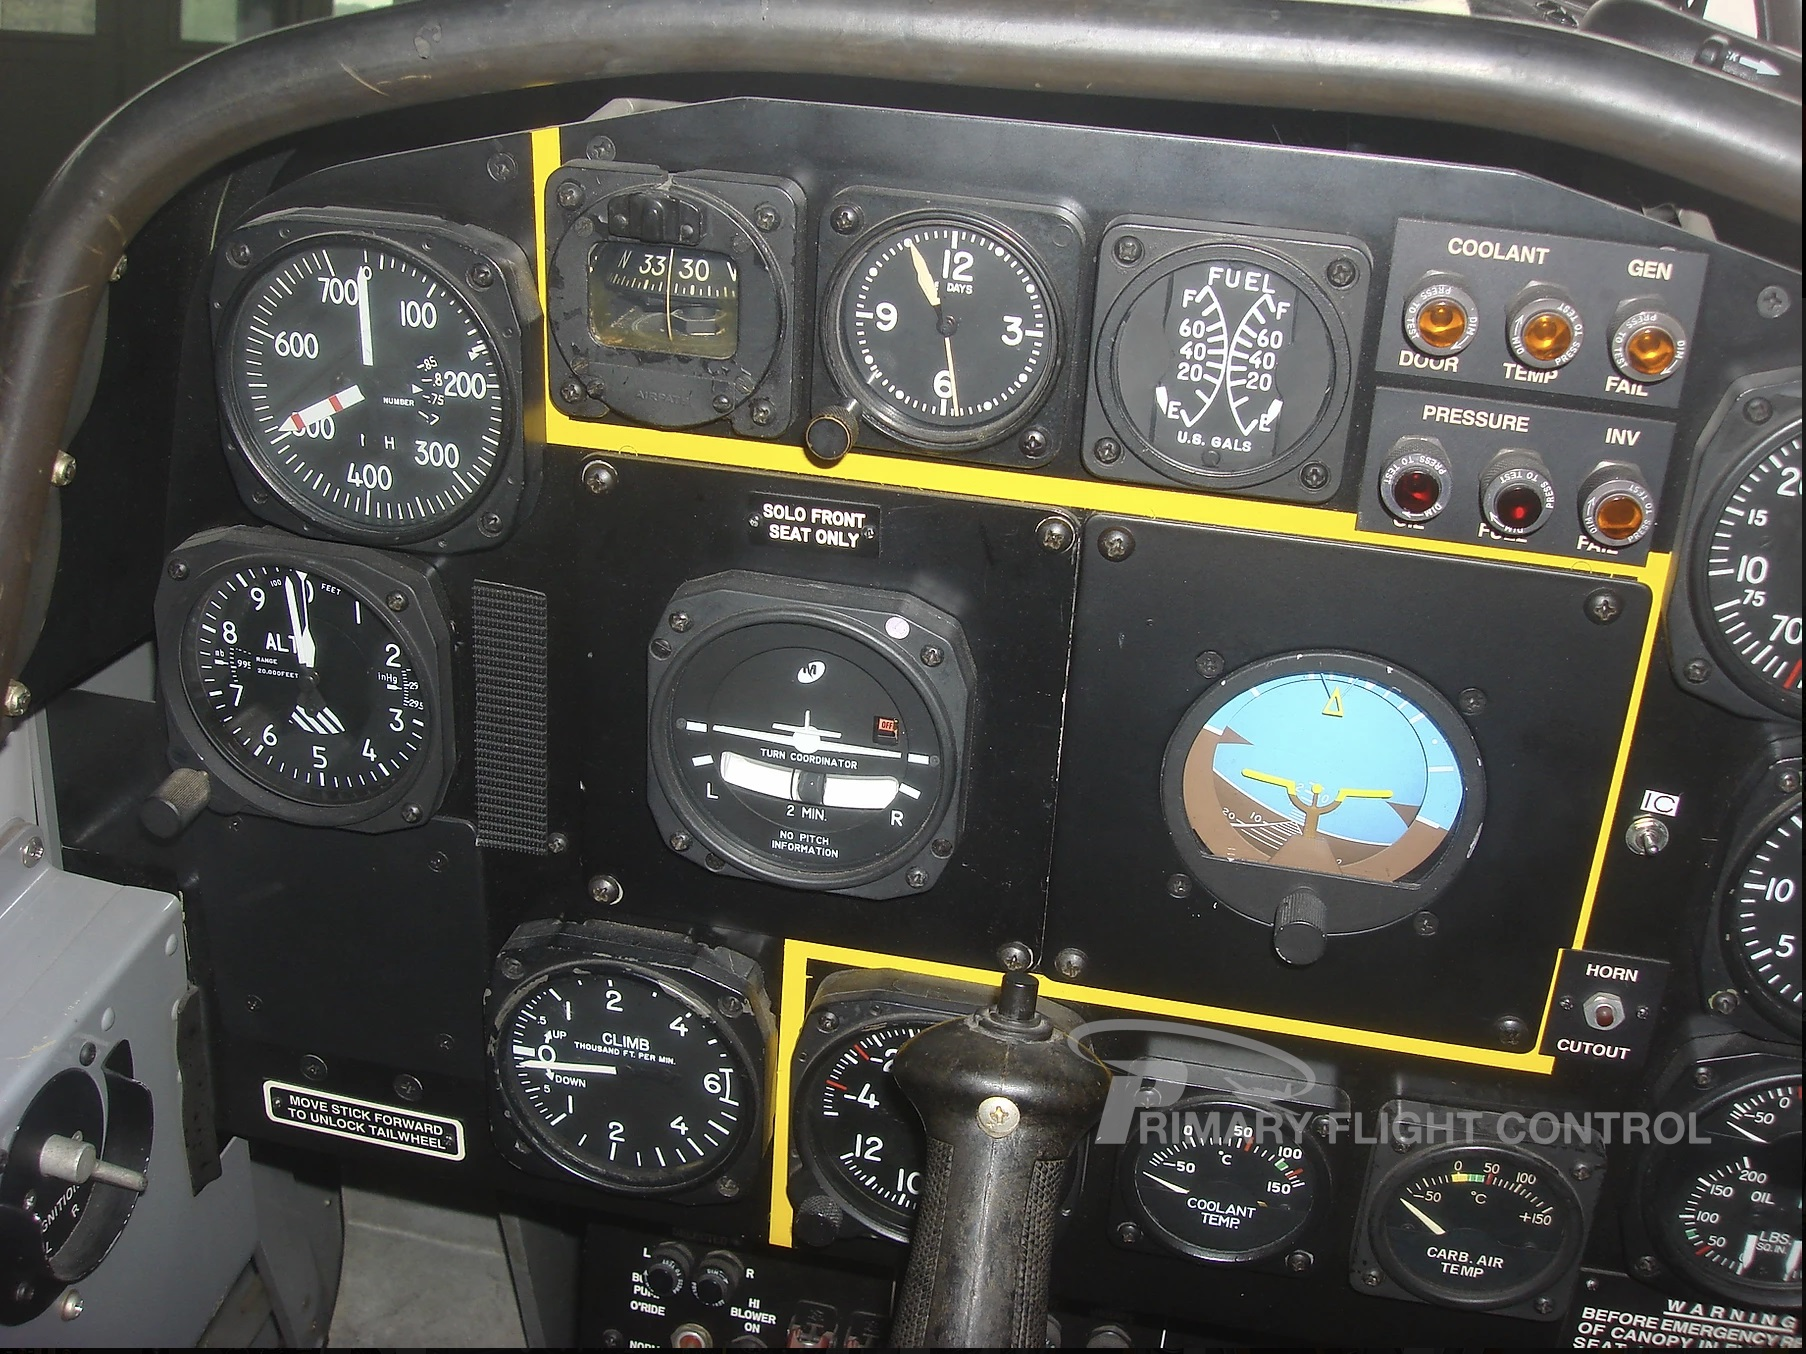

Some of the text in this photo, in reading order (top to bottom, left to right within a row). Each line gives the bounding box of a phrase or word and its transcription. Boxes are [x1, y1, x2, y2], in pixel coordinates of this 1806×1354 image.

[1447, 237, 1550, 265] COOLANT
[619, 250, 632, 268] N
[639, 254, 666, 276] 33
[679, 258, 710, 281] 30
[942, 249, 974, 282] 12
[1627, 258, 1673, 281] GEN
[946, 282, 973, 294] DAYS
[1207, 266, 1275, 294] FUEL
[317, 277, 358, 306] 700
[1182, 288, 1197, 308] F
[400, 300, 437, 329] 100
[875, 302, 898, 331] 9
[1276, 301, 1291, 320] F
[1406, 286, 1452, 339] PRESS TO TEST
[1001, 315, 1023, 346] 3
[1179, 318, 1206, 338] 60
[1466, 316, 1478, 336] DIM
[1554, 302, 1583, 366] PRESS TO TEST
[274, 331, 319, 360] 600
[1257, 329, 1283, 349] 60
[1512, 336, 1525, 355] DIM
[1614, 314, 1658, 369] PRESS TEST
[1675, 340, 1685, 359] DIM
[1180, 340, 1206, 361] 40
[1249, 351, 1275, 370] 40
[1176, 361, 1203, 382] 20
[1399, 350, 1459, 373] DOOR
[1246, 371, 1272, 392] 20
[1503, 362, 1558, 384] TEMP
[444, 370, 487, 399] 200
[933, 370, 953, 399] 6
[1605, 375, 1648, 397] FAIL
[383, 397, 415, 406] NUMBER
[1167, 400, 1182, 419] E
[1422, 404, 1530, 433] PRESSURE
[1177, 430, 1252, 452] U.S. GALS
[1605, 427, 1640, 447] INV
[414, 440, 460, 469] 300
[347, 462, 393, 491] 400
[1383, 455, 1447, 485] PRESS TO TEST
[1500, 471, 1555, 509] PRESS TO TEST
[763, 503, 866, 528] SOLO FRONT
[1423, 502, 1443, 517] DIM
[1747, 508, 1768, 527] 15
[1584, 516, 1598, 534] DIM
[768, 524, 860, 548] SEAT ONLY
[1736, 555, 1768, 585] 10
[250, 587, 265, 611] 9
[321, 583, 342, 596] FEET
[1742, 589, 1767, 608] 75
[222, 621, 238, 644] 8
[1769, 614, 1802, 645] 70
[385, 643, 401, 668] 2
[229, 683, 244, 707] 7
[389, 707, 405, 732] 3
[881, 720, 894, 730] OFF
[263, 723, 277, 747] 6
[312, 745, 328, 769] 5
[362, 738, 378, 762] 4
[760, 747, 858, 770] TURN COORDINATOR
[706, 782, 719, 800] L
[786, 804, 828, 822] 2 MIN.
[890, 809, 904, 827] R
[1221, 807, 1236, 820] 20
[1249, 811, 1263, 823] 10
[779, 829, 829, 846] NO PITCH
[771, 839, 839, 858] INFORMATION
[1765, 877, 1795, 903] 10
[1775, 934, 1795, 957] 5
[1585, 963, 1638, 982] HORN
[606, 989, 623, 1012] 2
[552, 1030, 567, 1039] UP
[669, 1016, 689, 1037] 4
[602, 1032, 650, 1051] CLIMB
[1557, 1038, 1631, 1060] CUTOUT
[574, 1041, 676, 1065] THOUSAND FT. PER MIN.
[555, 1074, 587, 1088] DOWN
[703, 1073, 721, 1095] 6
[1779, 1096, 1791, 1109] 0
[289, 1095, 444, 1136] MOVE STICK FORWARD
[670, 1116, 689, 1136] 4
[288, 1107, 447, 1150] TO UNLOCK TAILWHEEL
[608, 1121, 625, 1142] 2
[1183, 1125, 1193, 1136] 0
[1233, 1125, 1253, 1138] 50
[855, 1133, 884, 1162] 12
[1278, 1146, 1303, 1160] 100
[1454, 1160, 1463, 1171] 0
[1483, 1162, 1501, 1175] 50
[1516, 1171, 1537, 1185] 100
[1739, 1169, 1767, 1184] 200
[1267, 1181, 1291, 1195] 150
[1710, 1184, 1733, 1198] 150
[1751, 1190, 1775, 1205] OIL
[71, 1203, 80, 1218] R
[1186, 1197, 1256, 1219] COOLANT
[1518, 1211, 1552, 1226] +150
[1696, 1211, 1719, 1224] 100
[1201, 1212, 1241, 1229] TEMP.
[1707, 1235, 1726, 1248] 50
[1759, 1230, 1792, 1246] LBS.
[643, 1247, 651, 1258] L
[1426, 1246, 1504, 1269] CARB. AIR
[746, 1268, 755, 1279] R
[1441, 1261, 1484, 1278] TEMP
[630, 1300, 666, 1317] O'RIDE
[748, 1297, 760, 1309] HI
[730, 1306, 777, 1325] BLOWER
[1667, 1299, 1797, 1329] WARNING
[744, 1322, 761, 1334] ON
[1578, 1321, 1693, 1348] OF CANOPY
[1581, 1306, 1660, 1330] BEFORE
[1660, 1318, 1780, 1348] EMERGENCY
